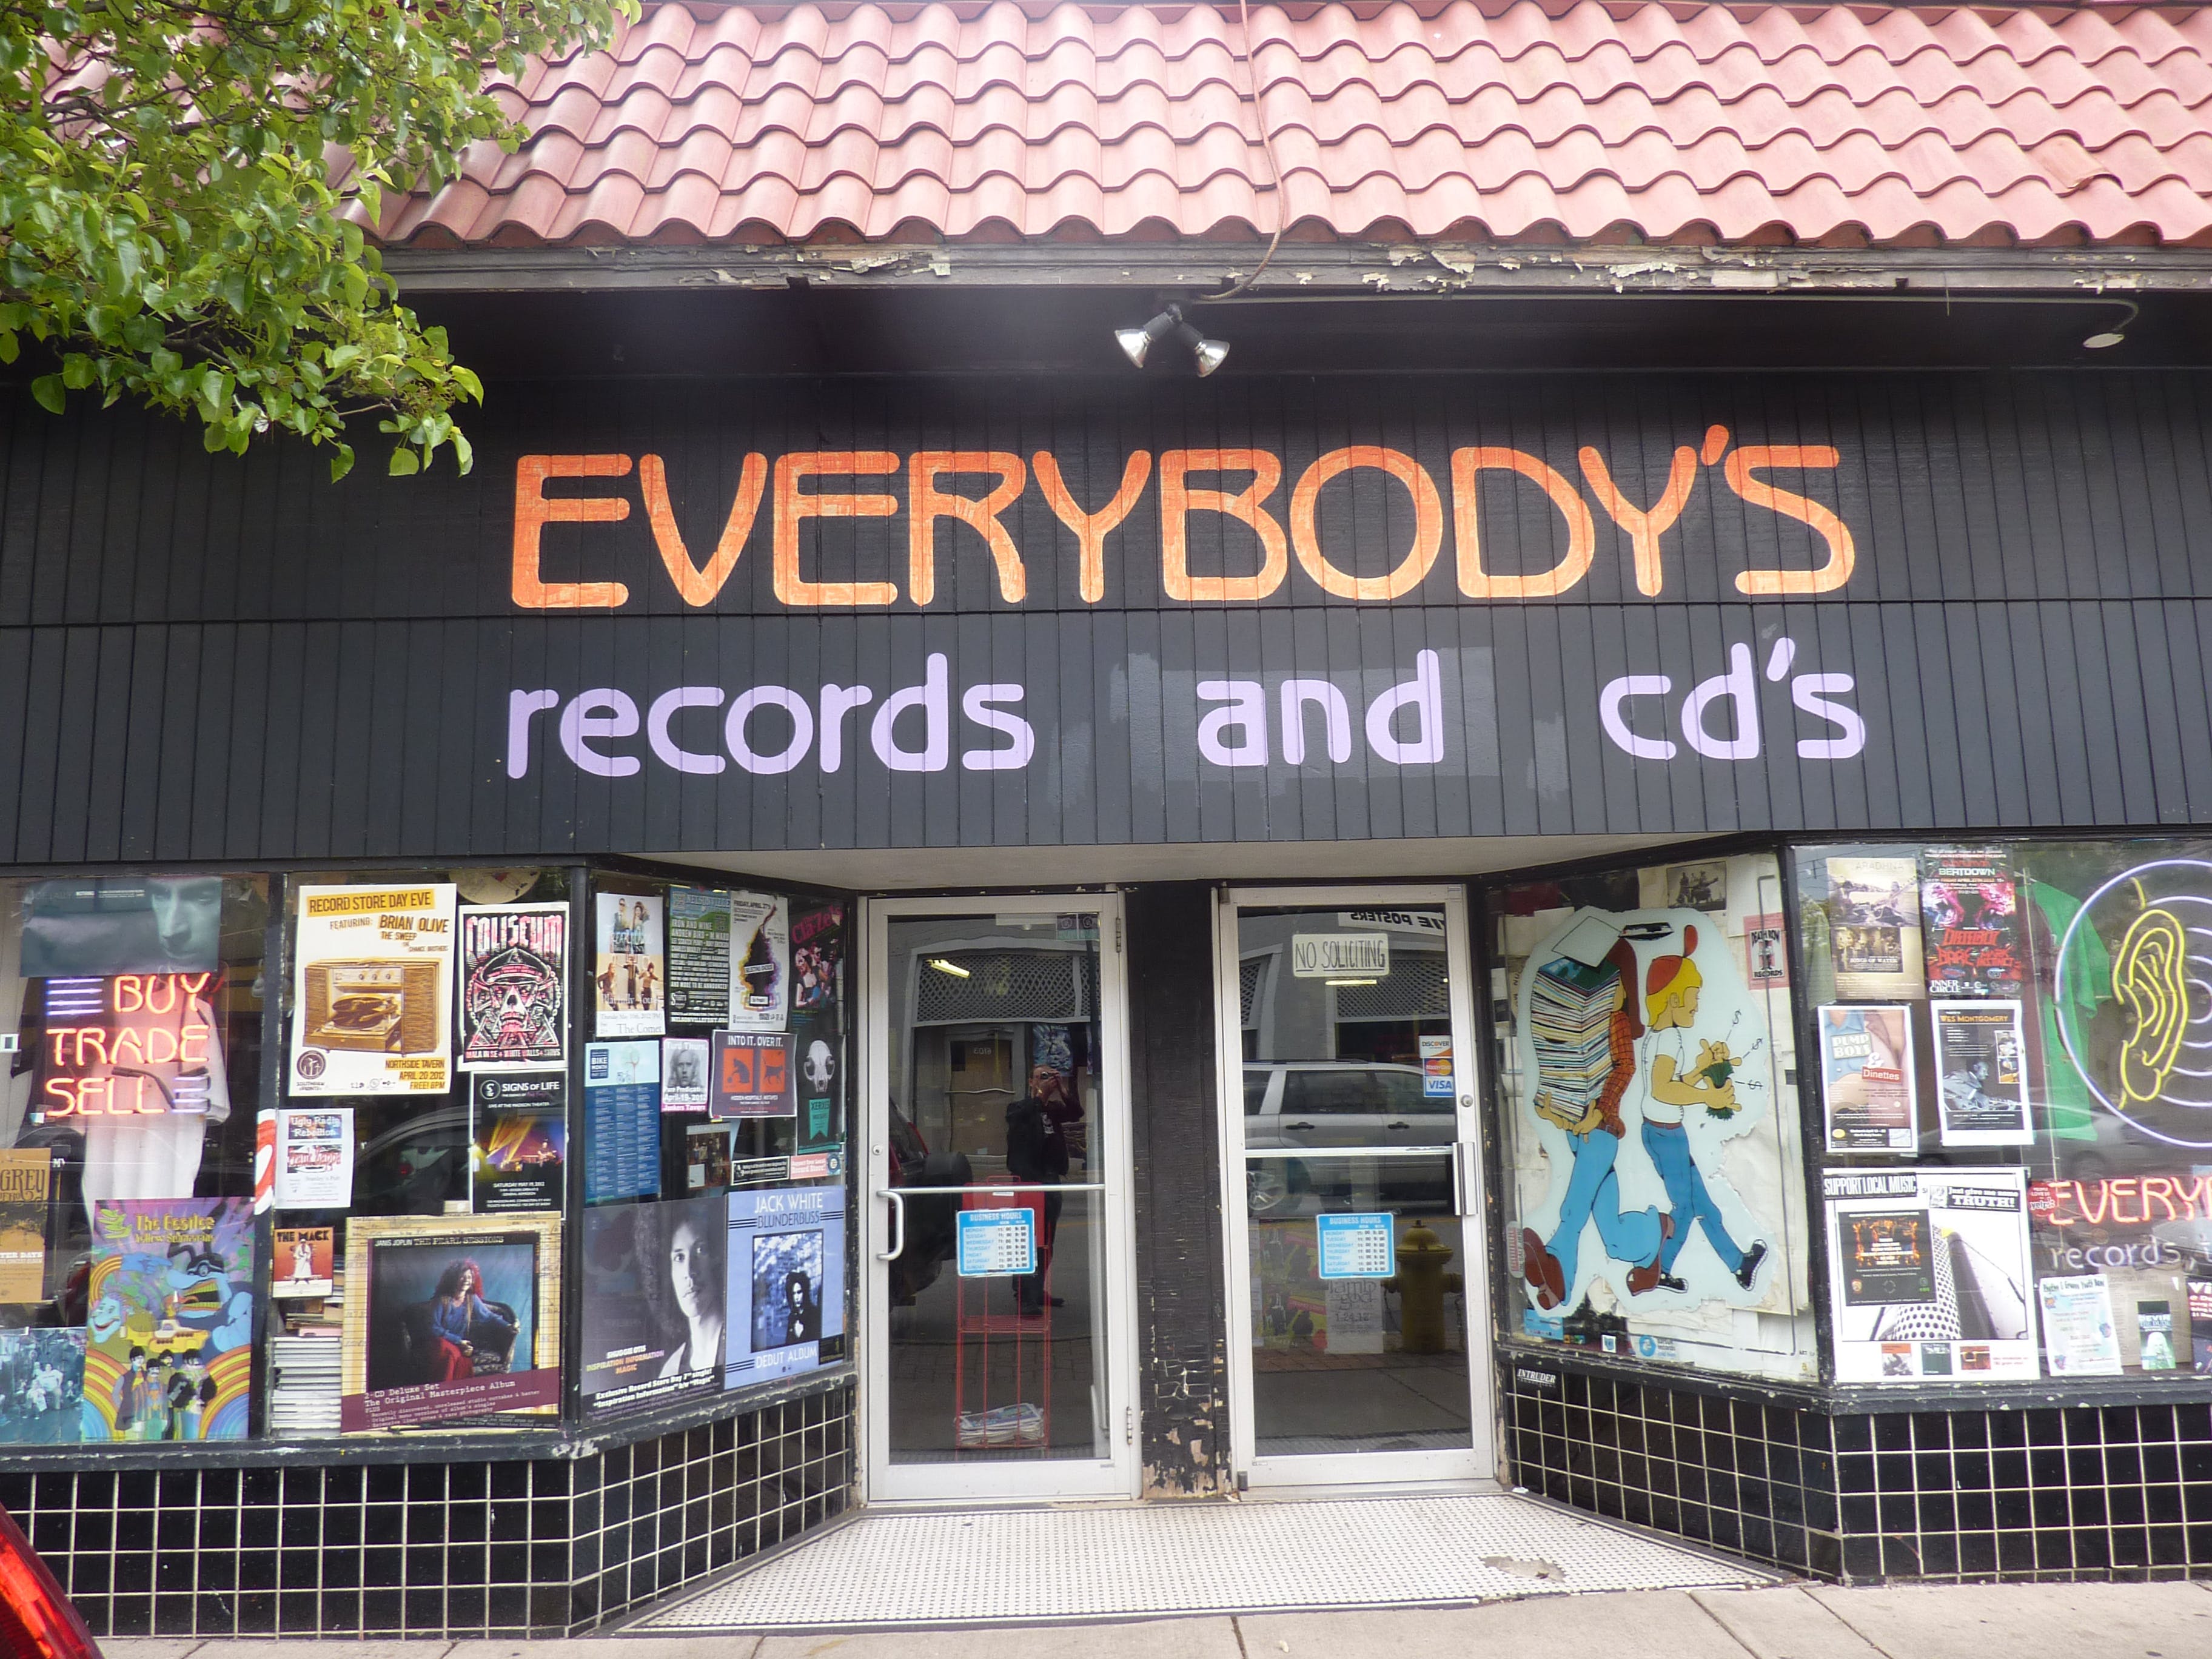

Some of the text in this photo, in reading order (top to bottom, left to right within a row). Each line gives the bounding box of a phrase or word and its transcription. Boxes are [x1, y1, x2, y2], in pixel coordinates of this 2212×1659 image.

[512, 424, 1855, 608] EVERYBODY'S
[507, 637, 1865, 779] records and cd's
[309, 892, 431, 913] RECORD STORE DAY EVE
[330, 914, 449, 933] FEATURING: BRIAN OLIVE
[381, 931, 417, 940] THE SWEEP
[466, 915, 563, 957] COLISEUM
[1295, 940, 1386, 969] NO SOLICITING
[113, 971, 212, 1014] BUY
[617, 1023, 662, 1034] The Comet
[45, 1024, 210, 1067] TRADE
[728, 1035, 746, 1046] INTO
[747, 1036, 757, 1047] IT.
[758, 1037, 775, 1047] OVER
[1832, 1034, 1869, 1047] PUMP
[1833, 1044, 1872, 1059] BOYS
[385, 1059, 445, 1069] NORTHSIDE TAVERN
[399, 1071, 417, 1081] APRIL
[429, 1071, 445, 1080] 2012
[1863, 1069, 1900, 1081] Dinettes
[409, 1081, 429, 1090] FREE!
[502, 1083, 529, 1092] SIGNS
[541, 1082, 560, 1090] LIFE
[1428, 1079, 1452, 1089] VISA
[45, 1075, 166, 1117] SELL
[290, 1116, 312, 1127] Ugly
[1824, 1175, 1917, 1196] SUPPORT LOCAL MUSIC
[1949, 1187, 1964, 1195] Just
[1965, 1188, 1982, 1197] give
[754, 1193, 823, 1213] JACK WHITE
[1952, 1196, 2016, 1208] TRUTH!
[2030, 1199, 2048, 1210] yelp
[2048, 1176, 2212, 1225] EVERY
[136, 1213, 161, 1231] The
[758, 1211, 820, 1228] BLUNDERBUSS
[970, 1213, 999, 1221] BUSINESS
[276, 1230, 330, 1242] THE MACK
[606, 1347, 633, 1359] SHUGGIE
[756, 1347, 818, 1369] DEBUT ALBUM
[586, 1350, 665, 1372] INSPIRATION INFORMATION
[615, 1363, 637, 1374] MAGIC
[1517, 1368, 1557, 1383] INTRUDER
[595, 1368, 712, 1400] Exclusive Record Store Day single!
[365, 1389, 385, 1400] 2-CD
[389, 1386, 420, 1396] Deluxe
[385, 1392, 425, 1404] Original
[429, 1384, 486, 1398] Masterpiece
[489, 1380, 515, 1390] Album
